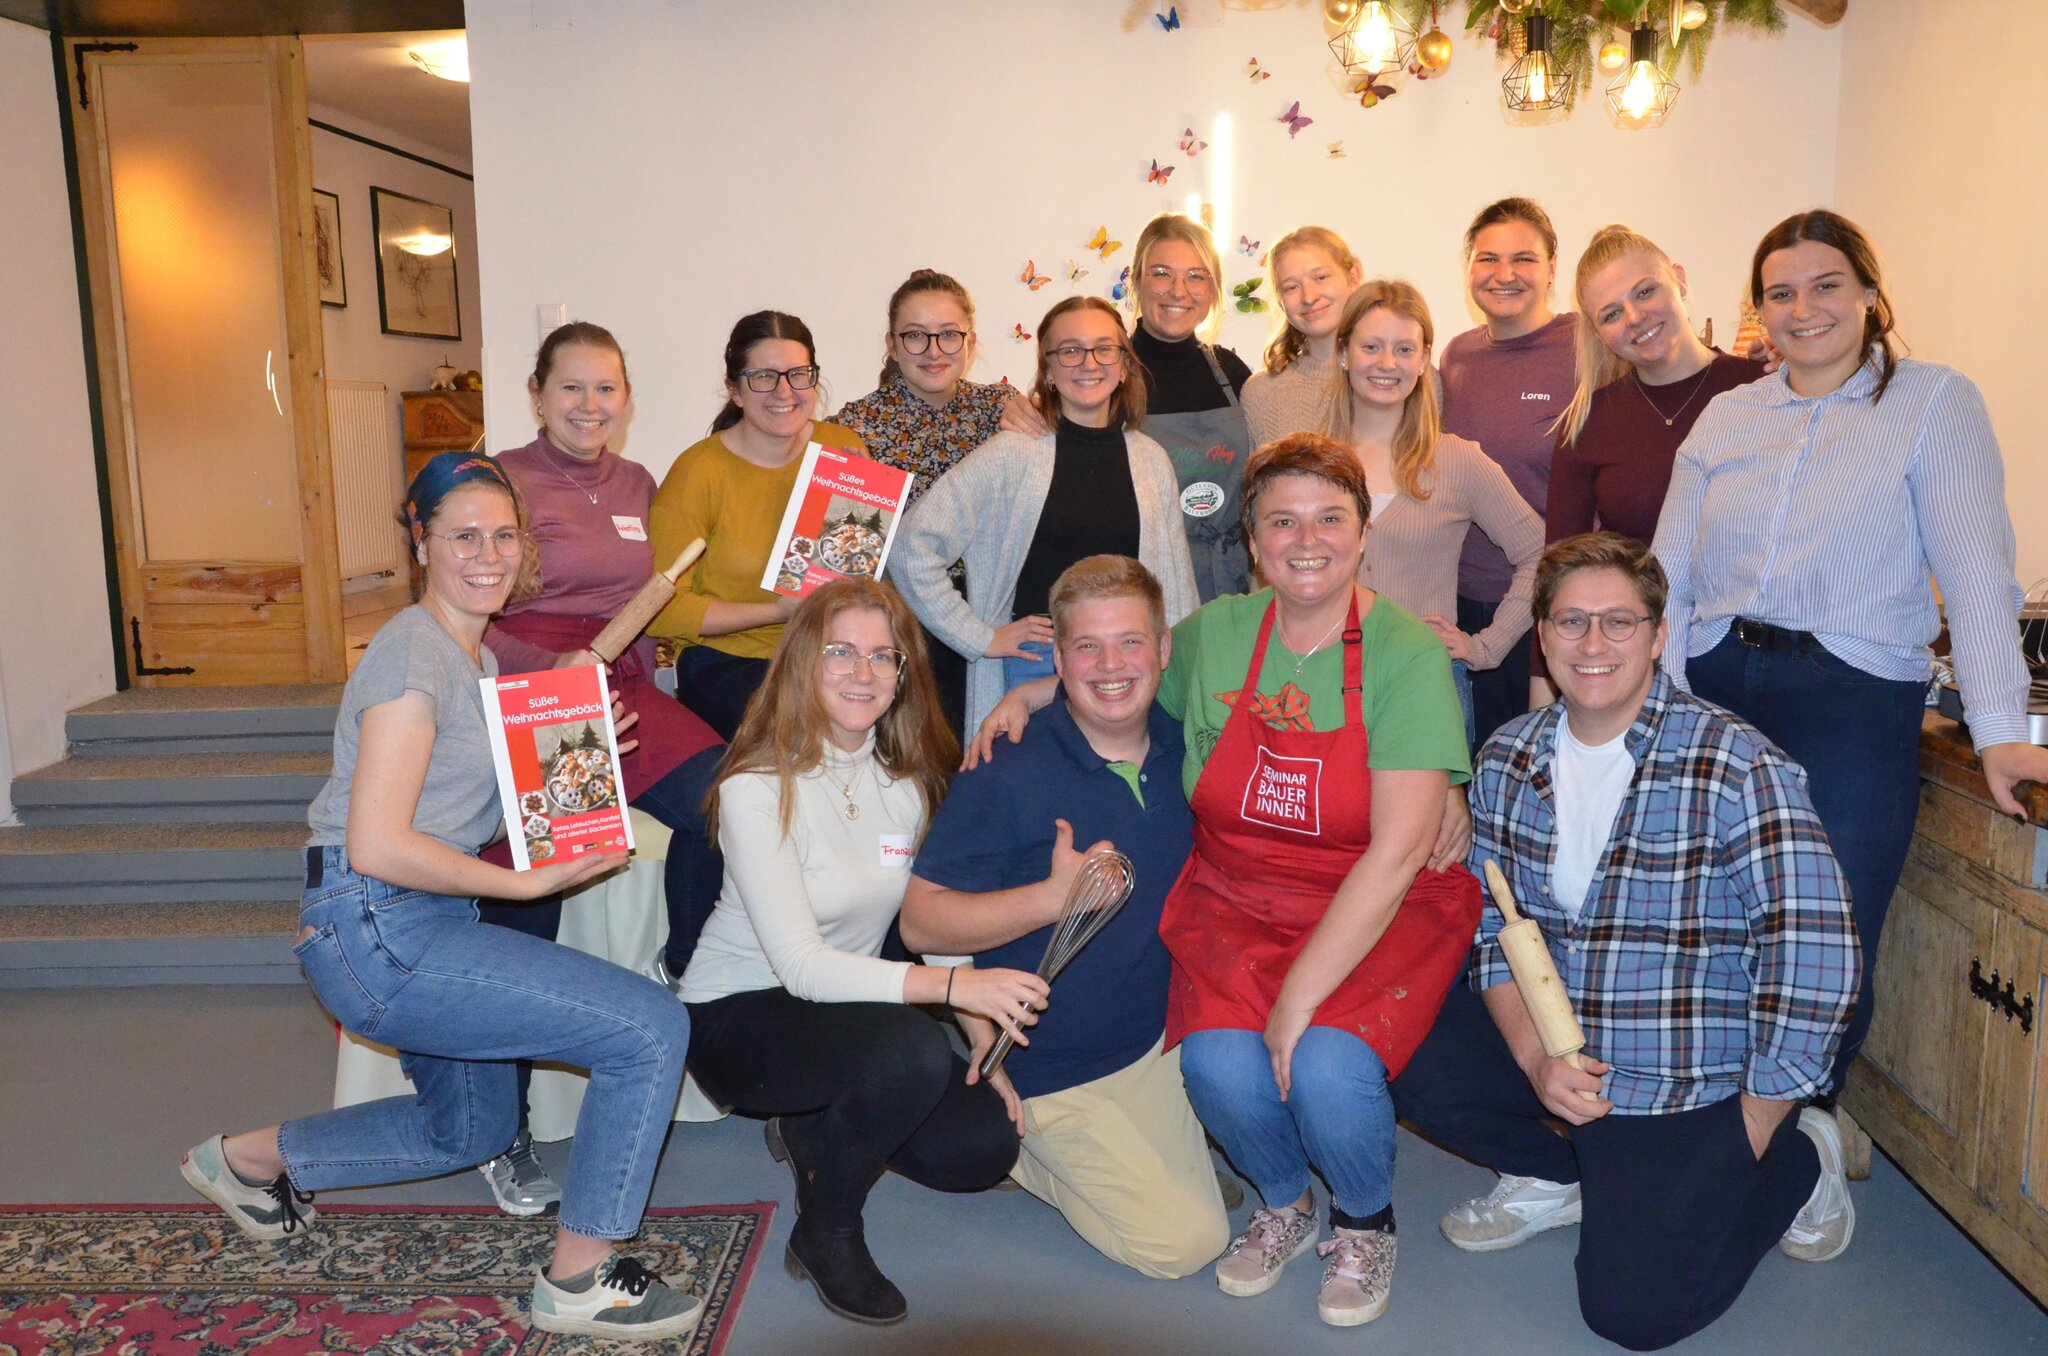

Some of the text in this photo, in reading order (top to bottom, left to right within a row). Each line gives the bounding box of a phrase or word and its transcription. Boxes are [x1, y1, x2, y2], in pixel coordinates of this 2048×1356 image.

[1521, 391, 1551, 401] Loren
[838, 472, 865, 486] Süßes
[812, 474, 898, 508] Weihnachtsgebäck
[528, 695, 559, 709] Süßes
[503, 702, 603, 725] Weihnachtsgebäck
[1262, 765, 1307, 786] SEMINAR
[1257, 779, 1306, 805] BÄUER
[1256, 796, 1306, 821] INNEN
[554, 832, 567, 840] und
